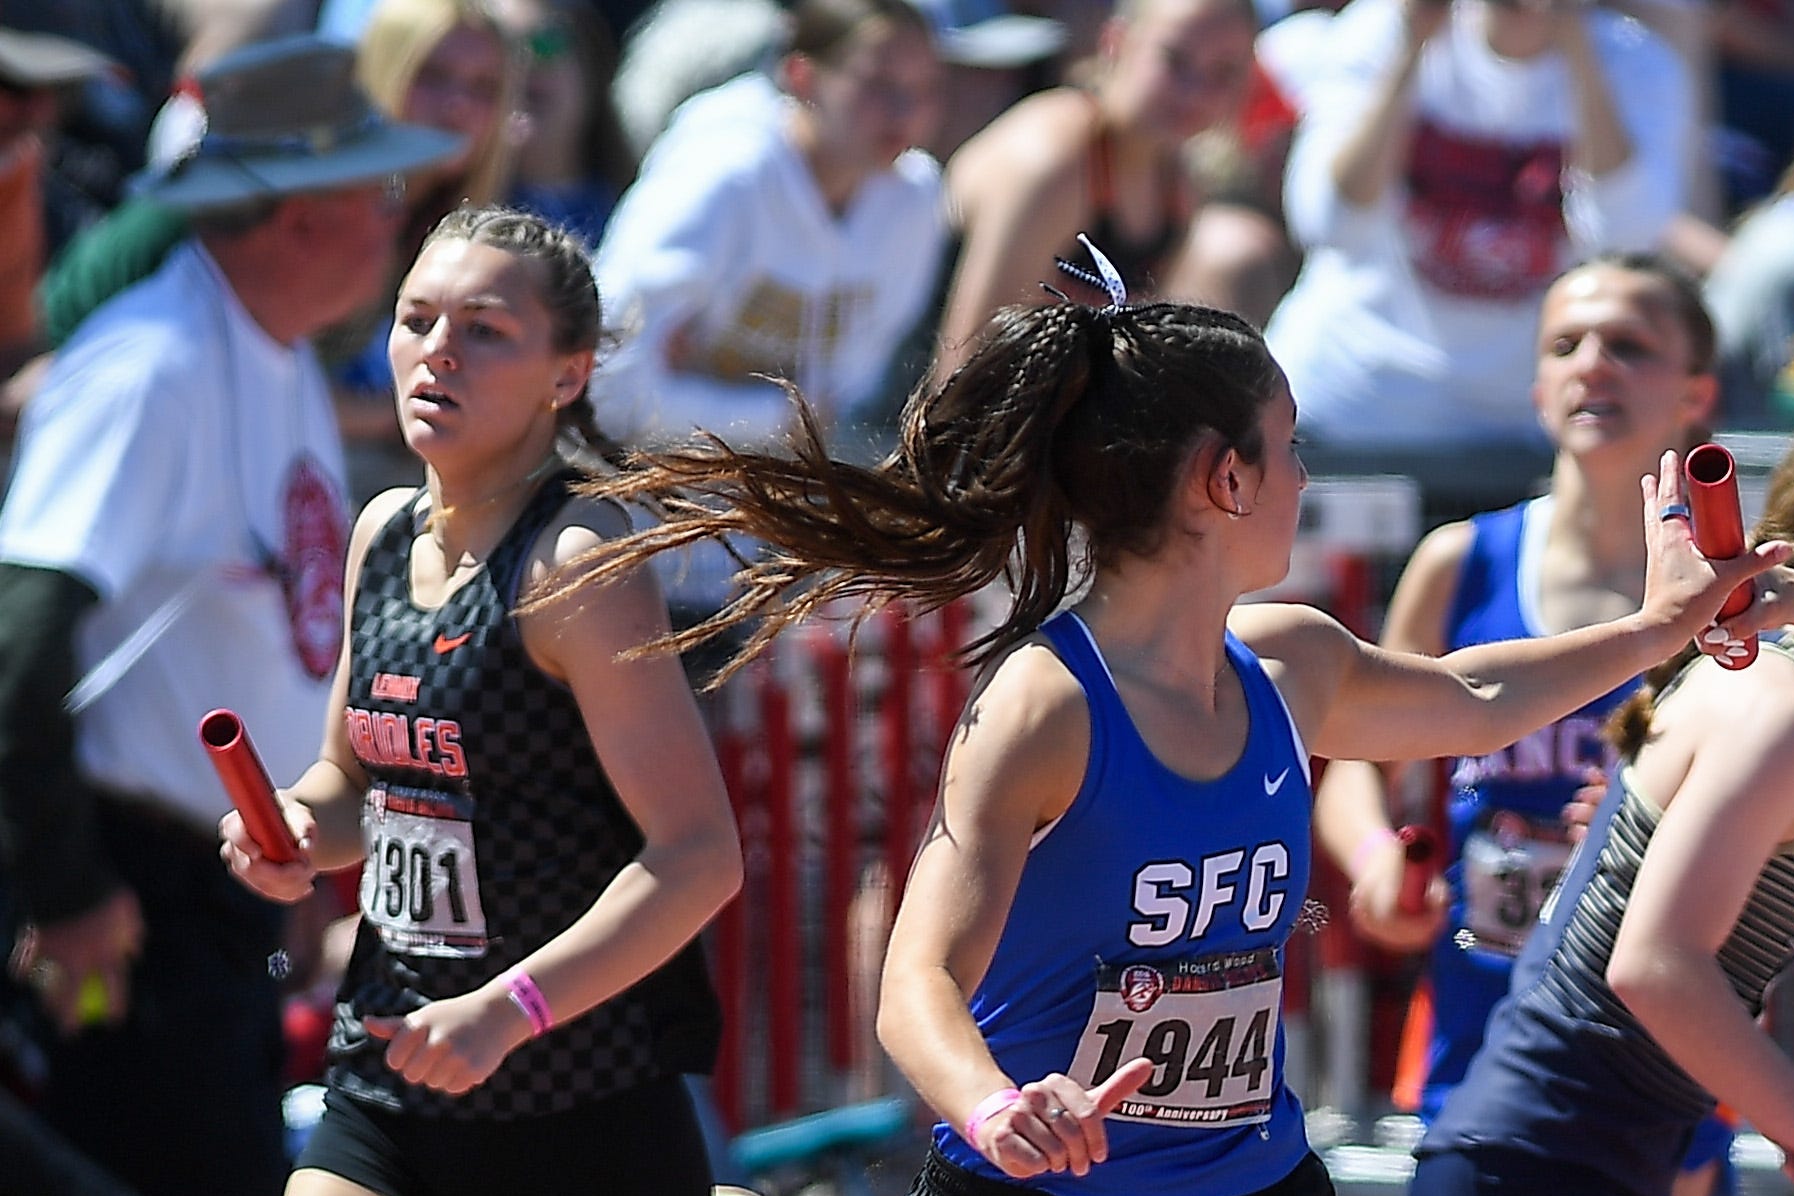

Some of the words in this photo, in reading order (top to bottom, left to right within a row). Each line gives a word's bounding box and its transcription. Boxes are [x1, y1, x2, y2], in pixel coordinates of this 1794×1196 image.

[370, 833, 471, 924] 1301
[1128, 840, 1291, 948] SFC
[1091, 1008, 1271, 1098] 1944
